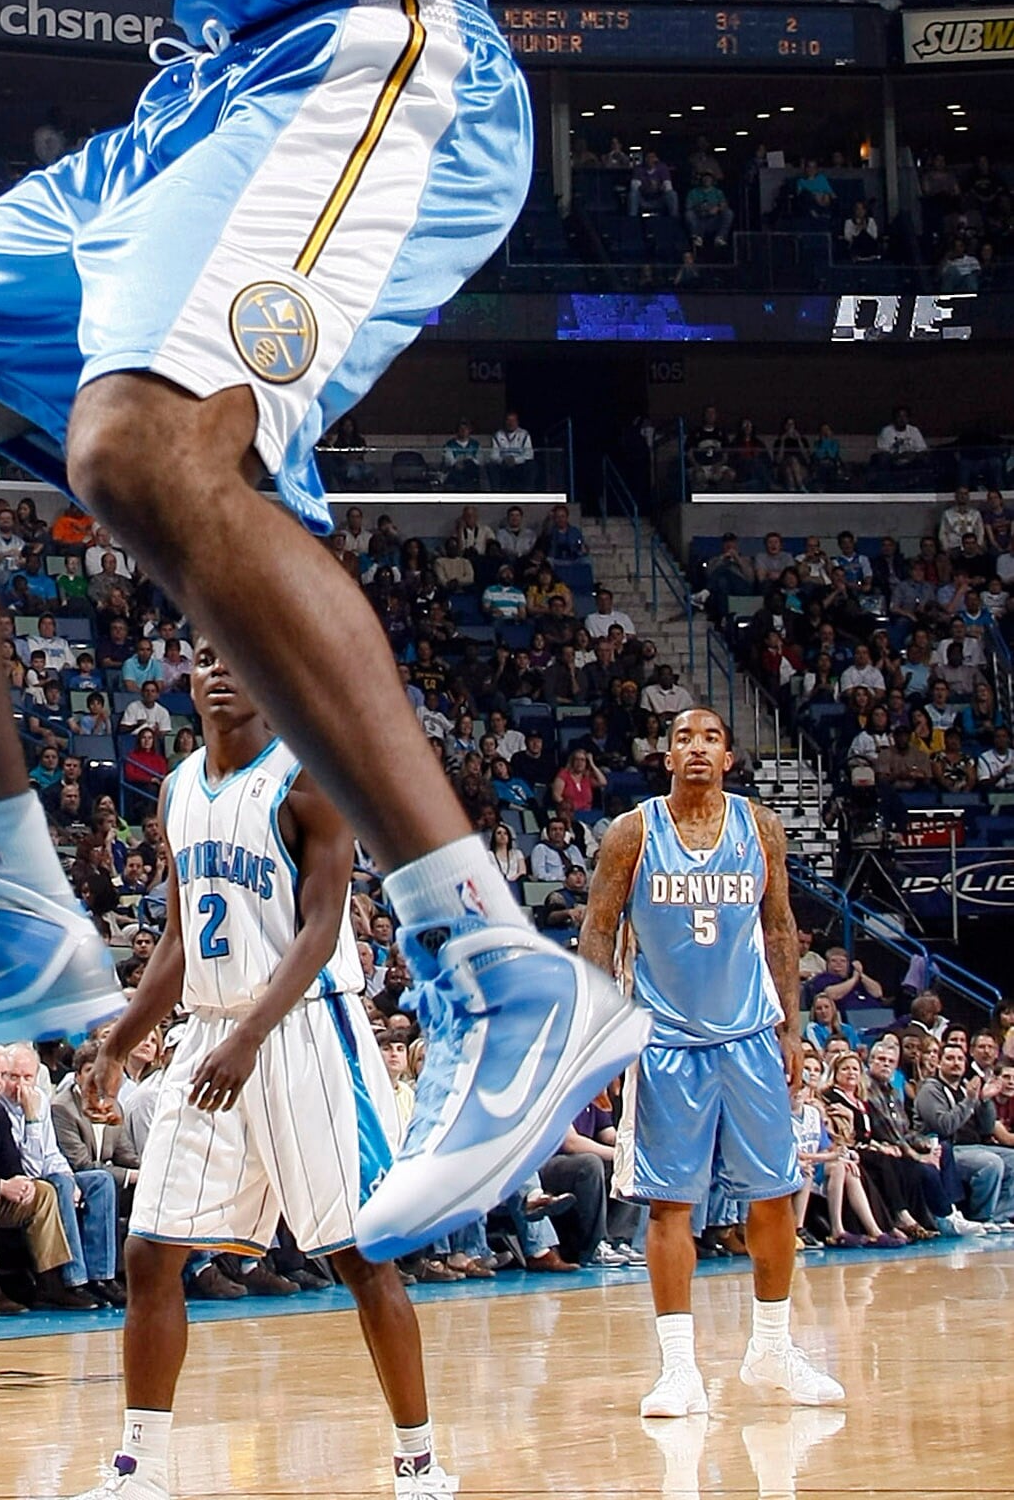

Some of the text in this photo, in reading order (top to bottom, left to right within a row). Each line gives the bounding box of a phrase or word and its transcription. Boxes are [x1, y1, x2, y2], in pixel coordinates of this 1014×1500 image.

[499, 9, 568, 30] JERSEY
[579, 10, 630, 30] METS
[786, 15, 799, 34] 2
[912, 18, 1014, 60] SUBW
[469, 361, 503, 381] 104
[650, 361, 683, 382] 105
[650, 873, 755, 905] DENVER
[198, 893, 230, 959] 2
[692, 908, 718, 946] 5
